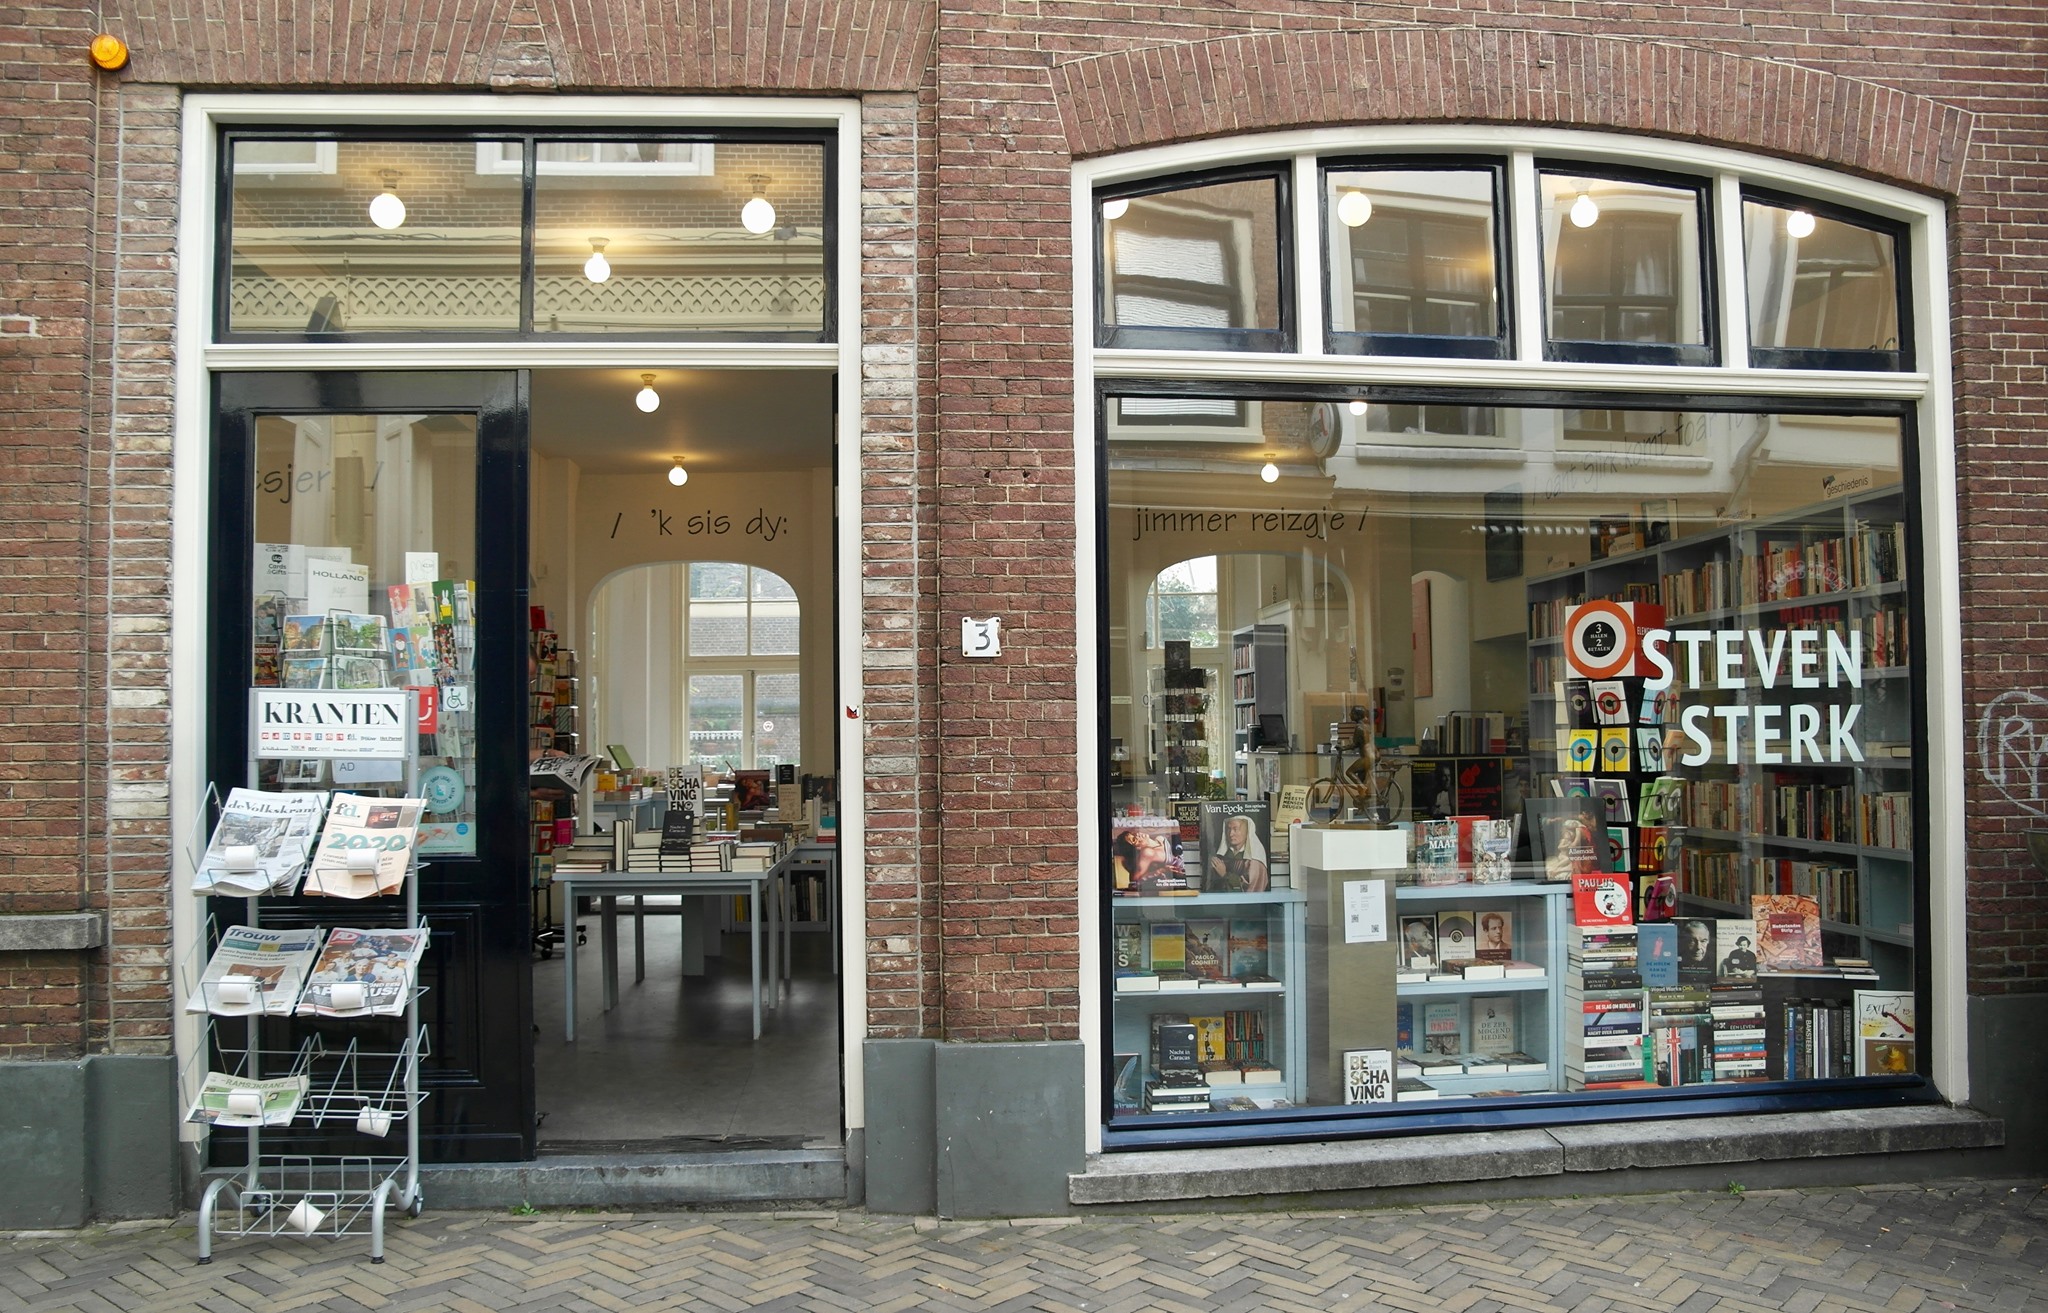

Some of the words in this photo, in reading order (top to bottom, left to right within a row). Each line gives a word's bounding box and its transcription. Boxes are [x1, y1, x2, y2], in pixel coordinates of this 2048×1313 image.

[1826, 475, 1869, 497] geschiedenis
[687, 510, 730, 535] sis
[1133, 507, 1237, 541] jimmer
[1251, 506, 1345, 539] reizgje
[313, 570, 364, 581] HOLLAND
[1595, 624, 1602, 634] 3
[975, 623, 990, 651] 3
[1596, 639, 1602, 647] 2
[1643, 630, 1862, 690] STEVEN
[265, 702, 401, 725] KRANTEN
[1681, 704, 1865, 766] STERK
[340, 762, 355, 771] AD
[668, 767, 683, 778] BE
[669, 778, 700, 790] SCHA
[669, 789, 697, 801] VING
[1204, 804, 1222, 813] Van
[1223, 804, 1244, 815] Eyck
[1114, 818, 1179, 828] Moesman
[326, 833, 406, 852] 2020
[1429, 840, 1457, 849] MAAT
[1578, 878, 1614, 888] PAULUS
[229, 928, 280, 940] Trouw
[332, 931, 359, 940] AD
[1477, 1027, 1511, 1035] MOGEND
[1350, 1055, 1368, 1070] BE
[1350, 1069, 1390, 1085] SCHA
[1350, 1085, 1384, 1100] VING
